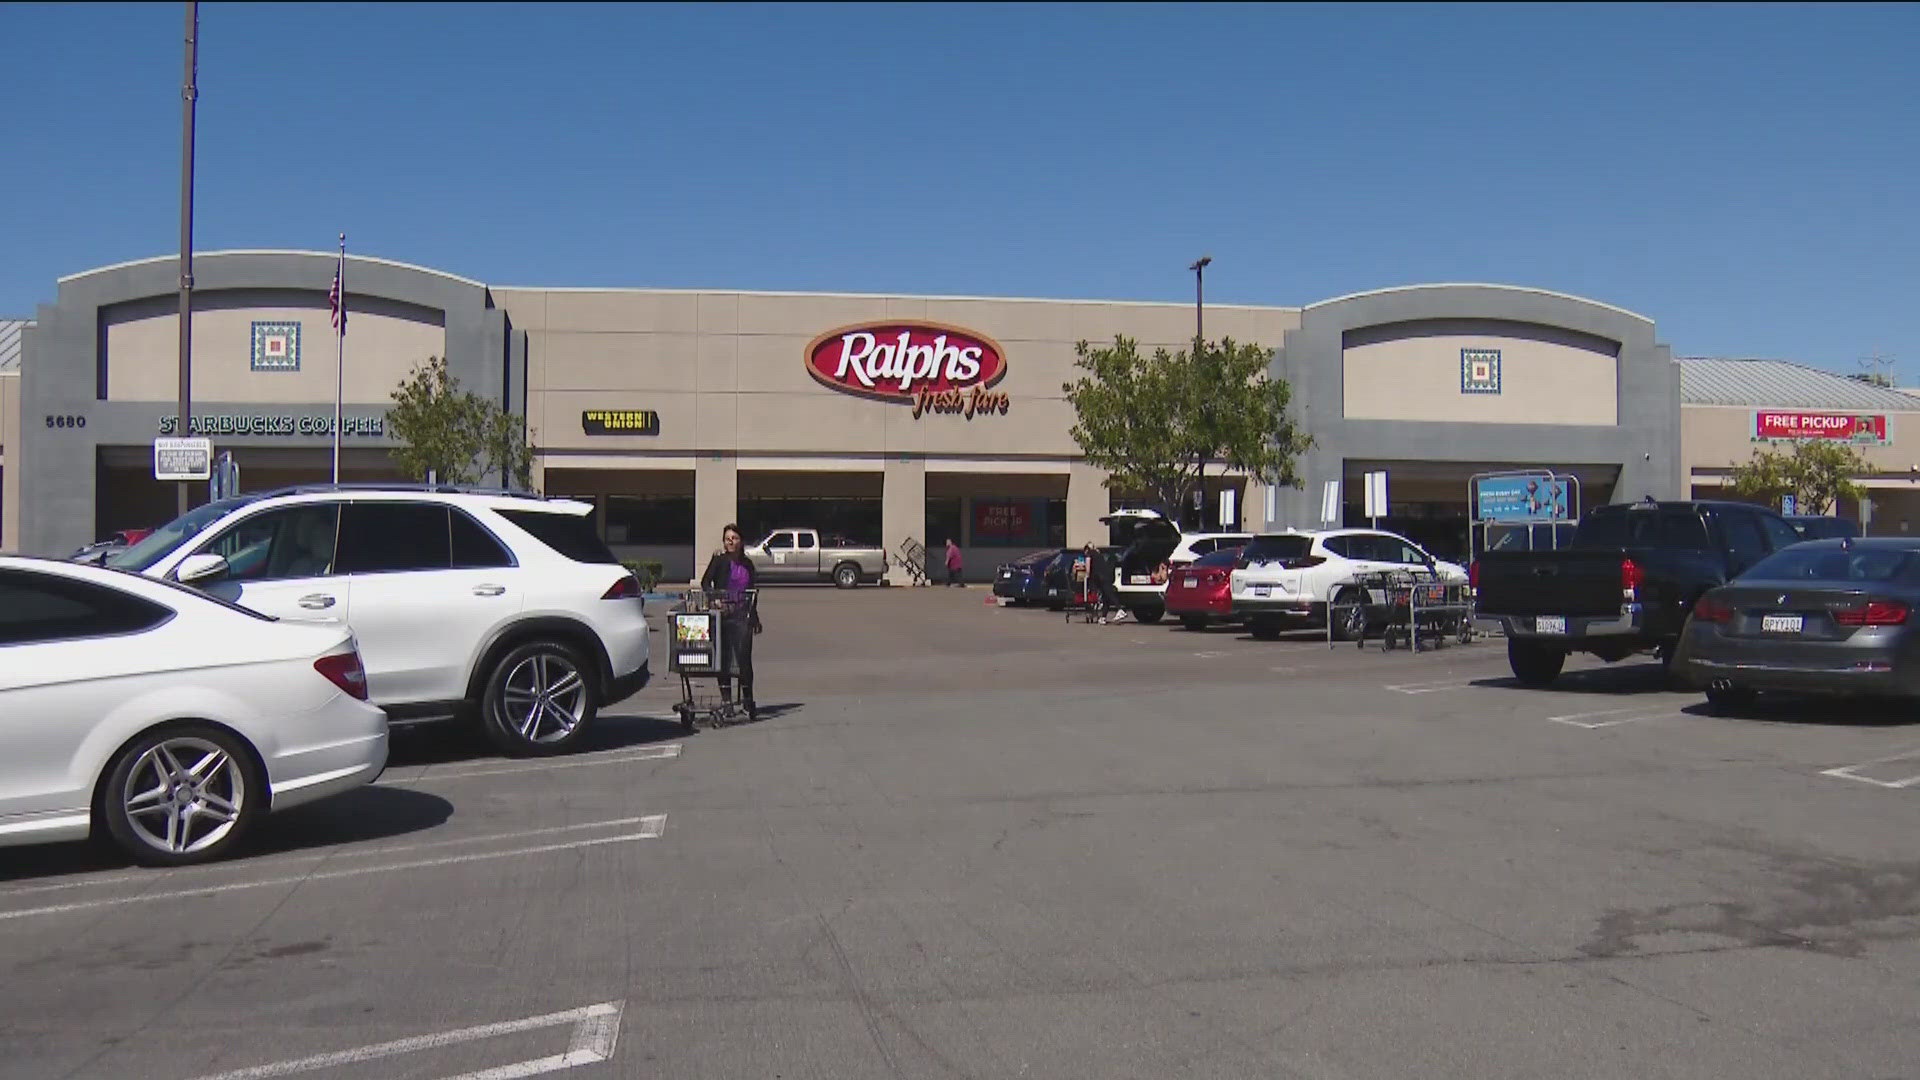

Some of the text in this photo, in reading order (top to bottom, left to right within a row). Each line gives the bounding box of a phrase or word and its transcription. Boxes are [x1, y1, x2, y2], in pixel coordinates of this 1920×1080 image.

[833, 330, 983, 391] Ralphs
[912, 383, 1010, 420] fresh fare
[586, 412, 642, 420] WESTERN
[1765, 415, 1848, 429] FREE PICKUP
[297, 415, 382, 433] COFFEE
[604, 420, 642, 429] UNION
[988, 506, 1017, 516] FREE
